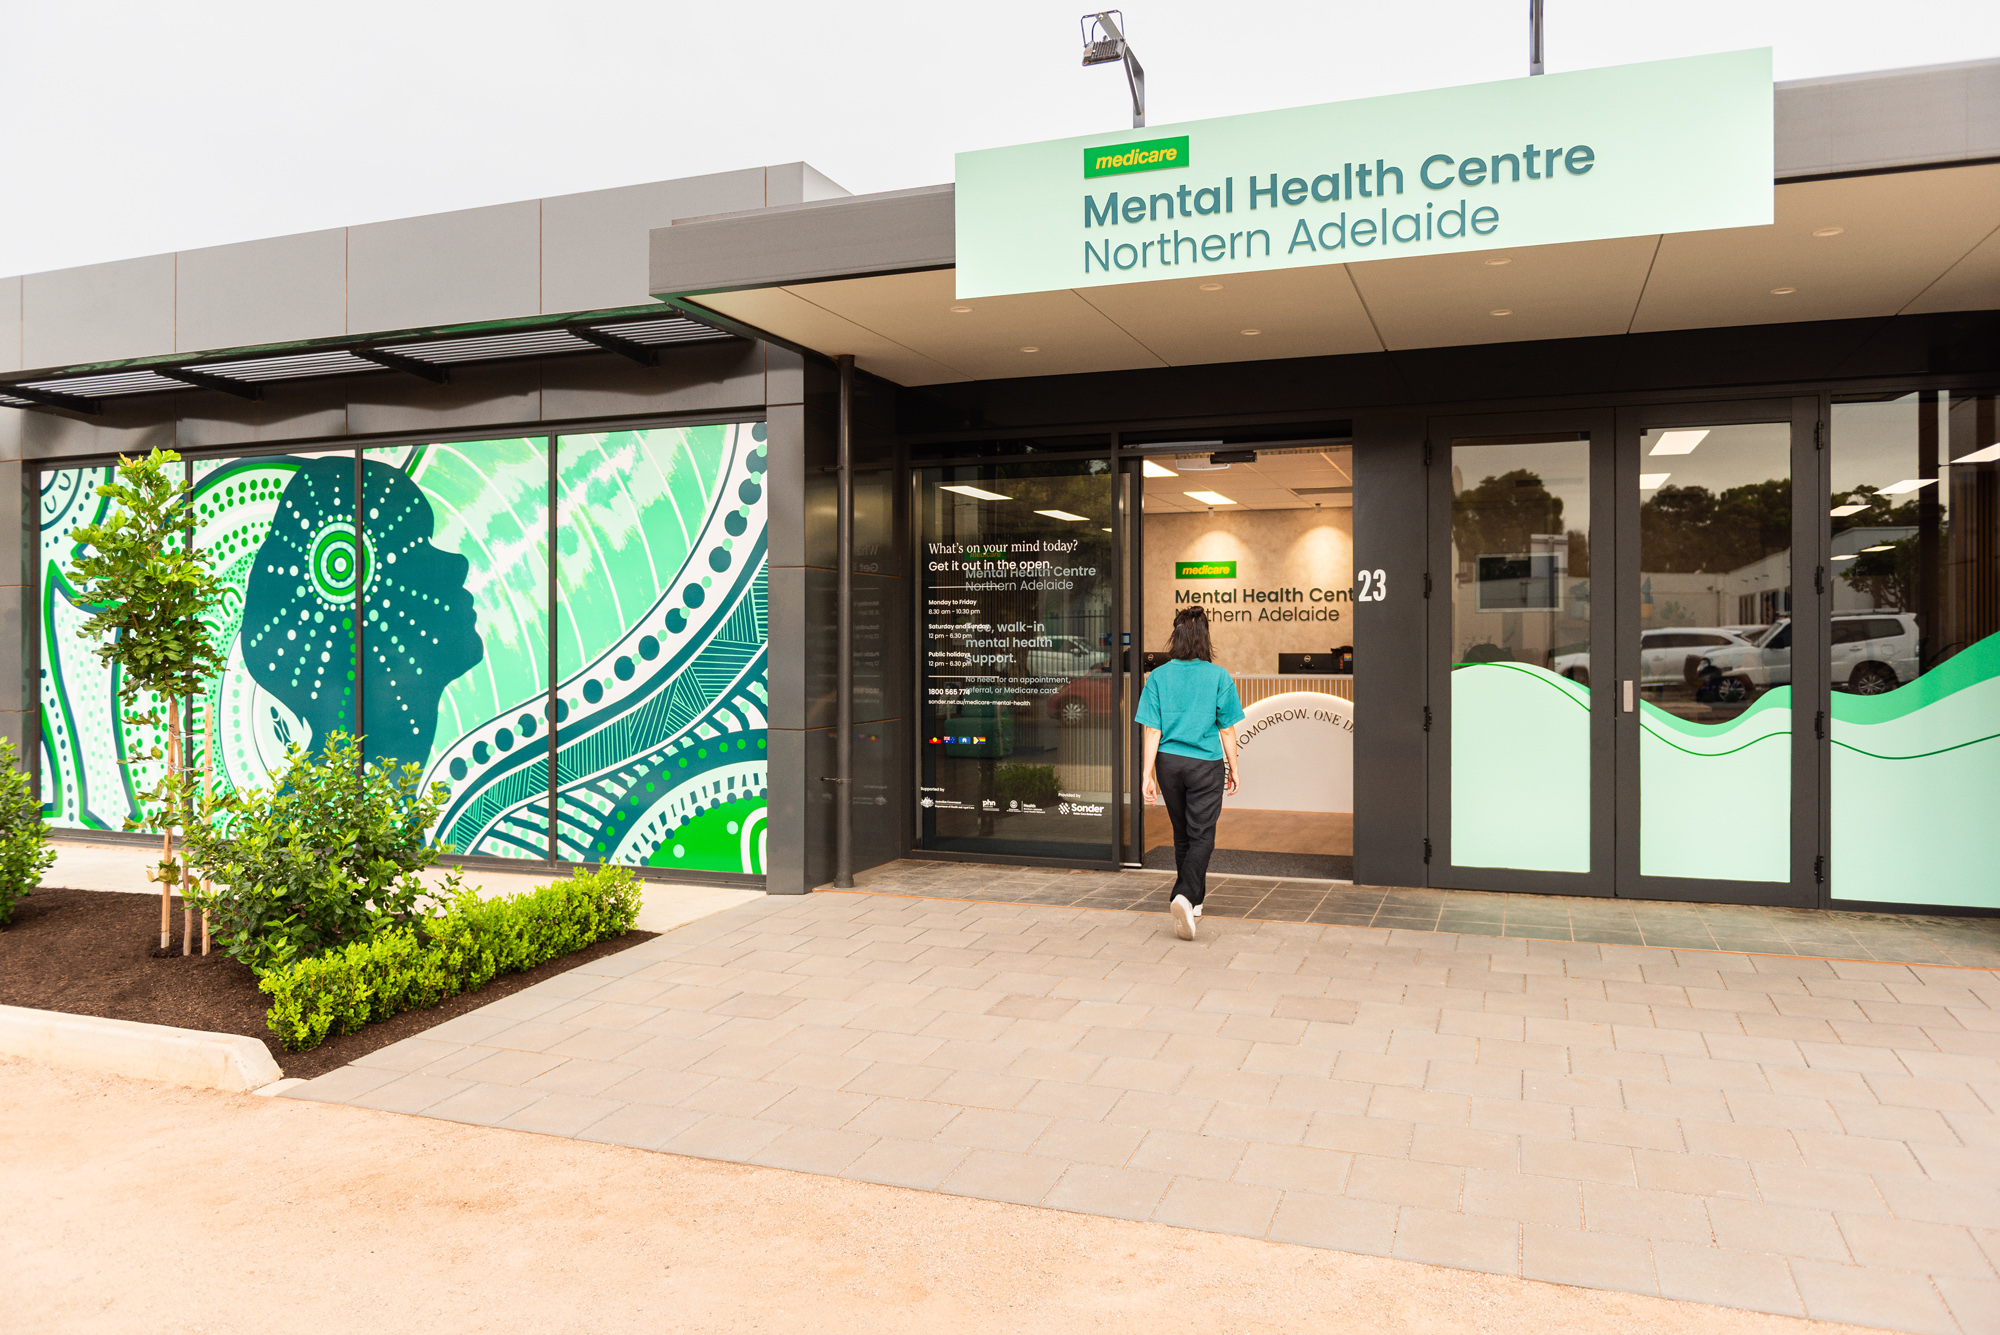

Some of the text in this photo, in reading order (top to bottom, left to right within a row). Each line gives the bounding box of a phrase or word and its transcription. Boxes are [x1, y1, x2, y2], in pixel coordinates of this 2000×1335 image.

[1095, 145, 1177, 170] medicare
[1084, 143, 1595, 228] Mental Health Centre
[1084, 199, 1500, 273] Northern Adelaide
[928, 539, 1078, 555] What's on your mind today?
[970, 548, 1002, 558] medicare
[928, 559, 1053, 572] Get it out in the open.
[966, 566, 1096, 578] Mental Health Centre
[1182, 565, 1230, 575] medicare
[966, 579, 1074, 592] Northern Adelaide
[1358, 569, 1387, 602] 23
[1175, 587, 1354, 604] Mental Health Cent
[1258, 606, 1340, 622] Adelaide
[966, 621, 1045, 634] Free, walk-in
[966, 636, 1052, 648] mental health
[966, 653, 1017, 666] support.
[1020, 677, 1070, 685] appointment,
[1236, 708, 1310, 749] TOMORROW.
[1314, 709, 1342, 725] ONE
[982, 799, 996, 807] phn
[1071, 803, 1104, 813] Sonder
